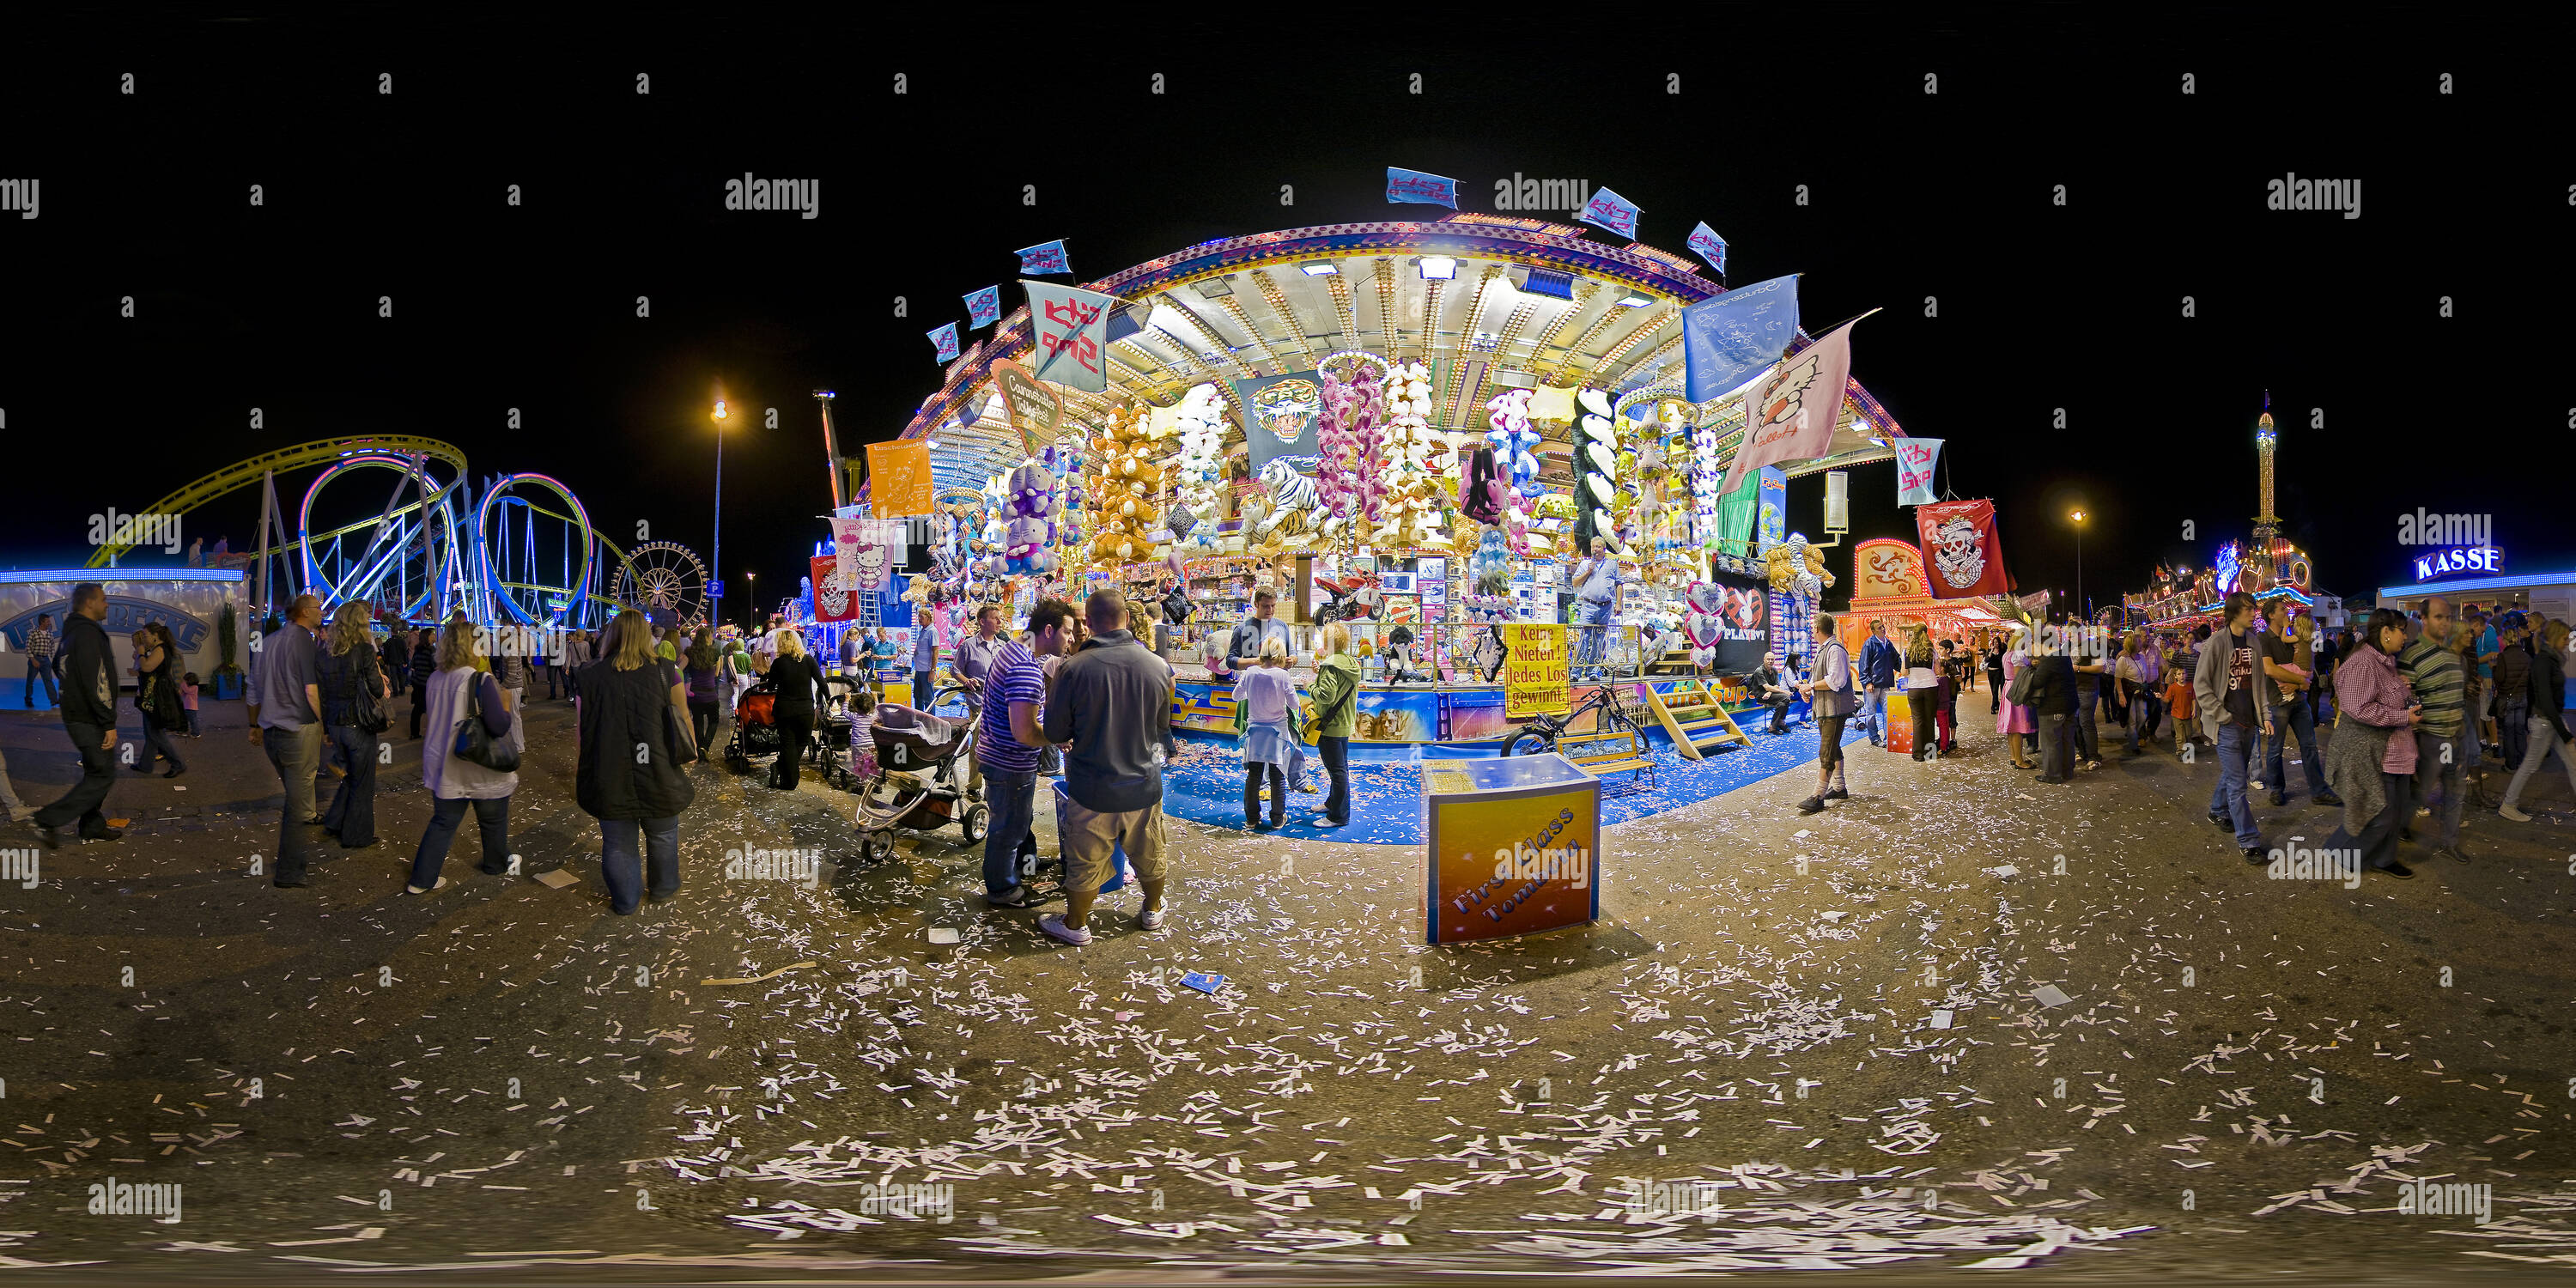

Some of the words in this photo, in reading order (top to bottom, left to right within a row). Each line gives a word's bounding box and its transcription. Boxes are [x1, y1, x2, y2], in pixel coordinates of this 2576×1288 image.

[2417, 548, 2500, 580] KASSE
[1520, 624, 1553, 641] Keine
[1509, 666, 1541, 686] Jedes
[1546, 666, 1565, 681] Los
[1512, 686, 1565, 709] gewinnt.
[1451, 861, 1514, 914] First
[1516, 806, 1575, 866] Class
[1482, 838, 1583, 922] Tombola
